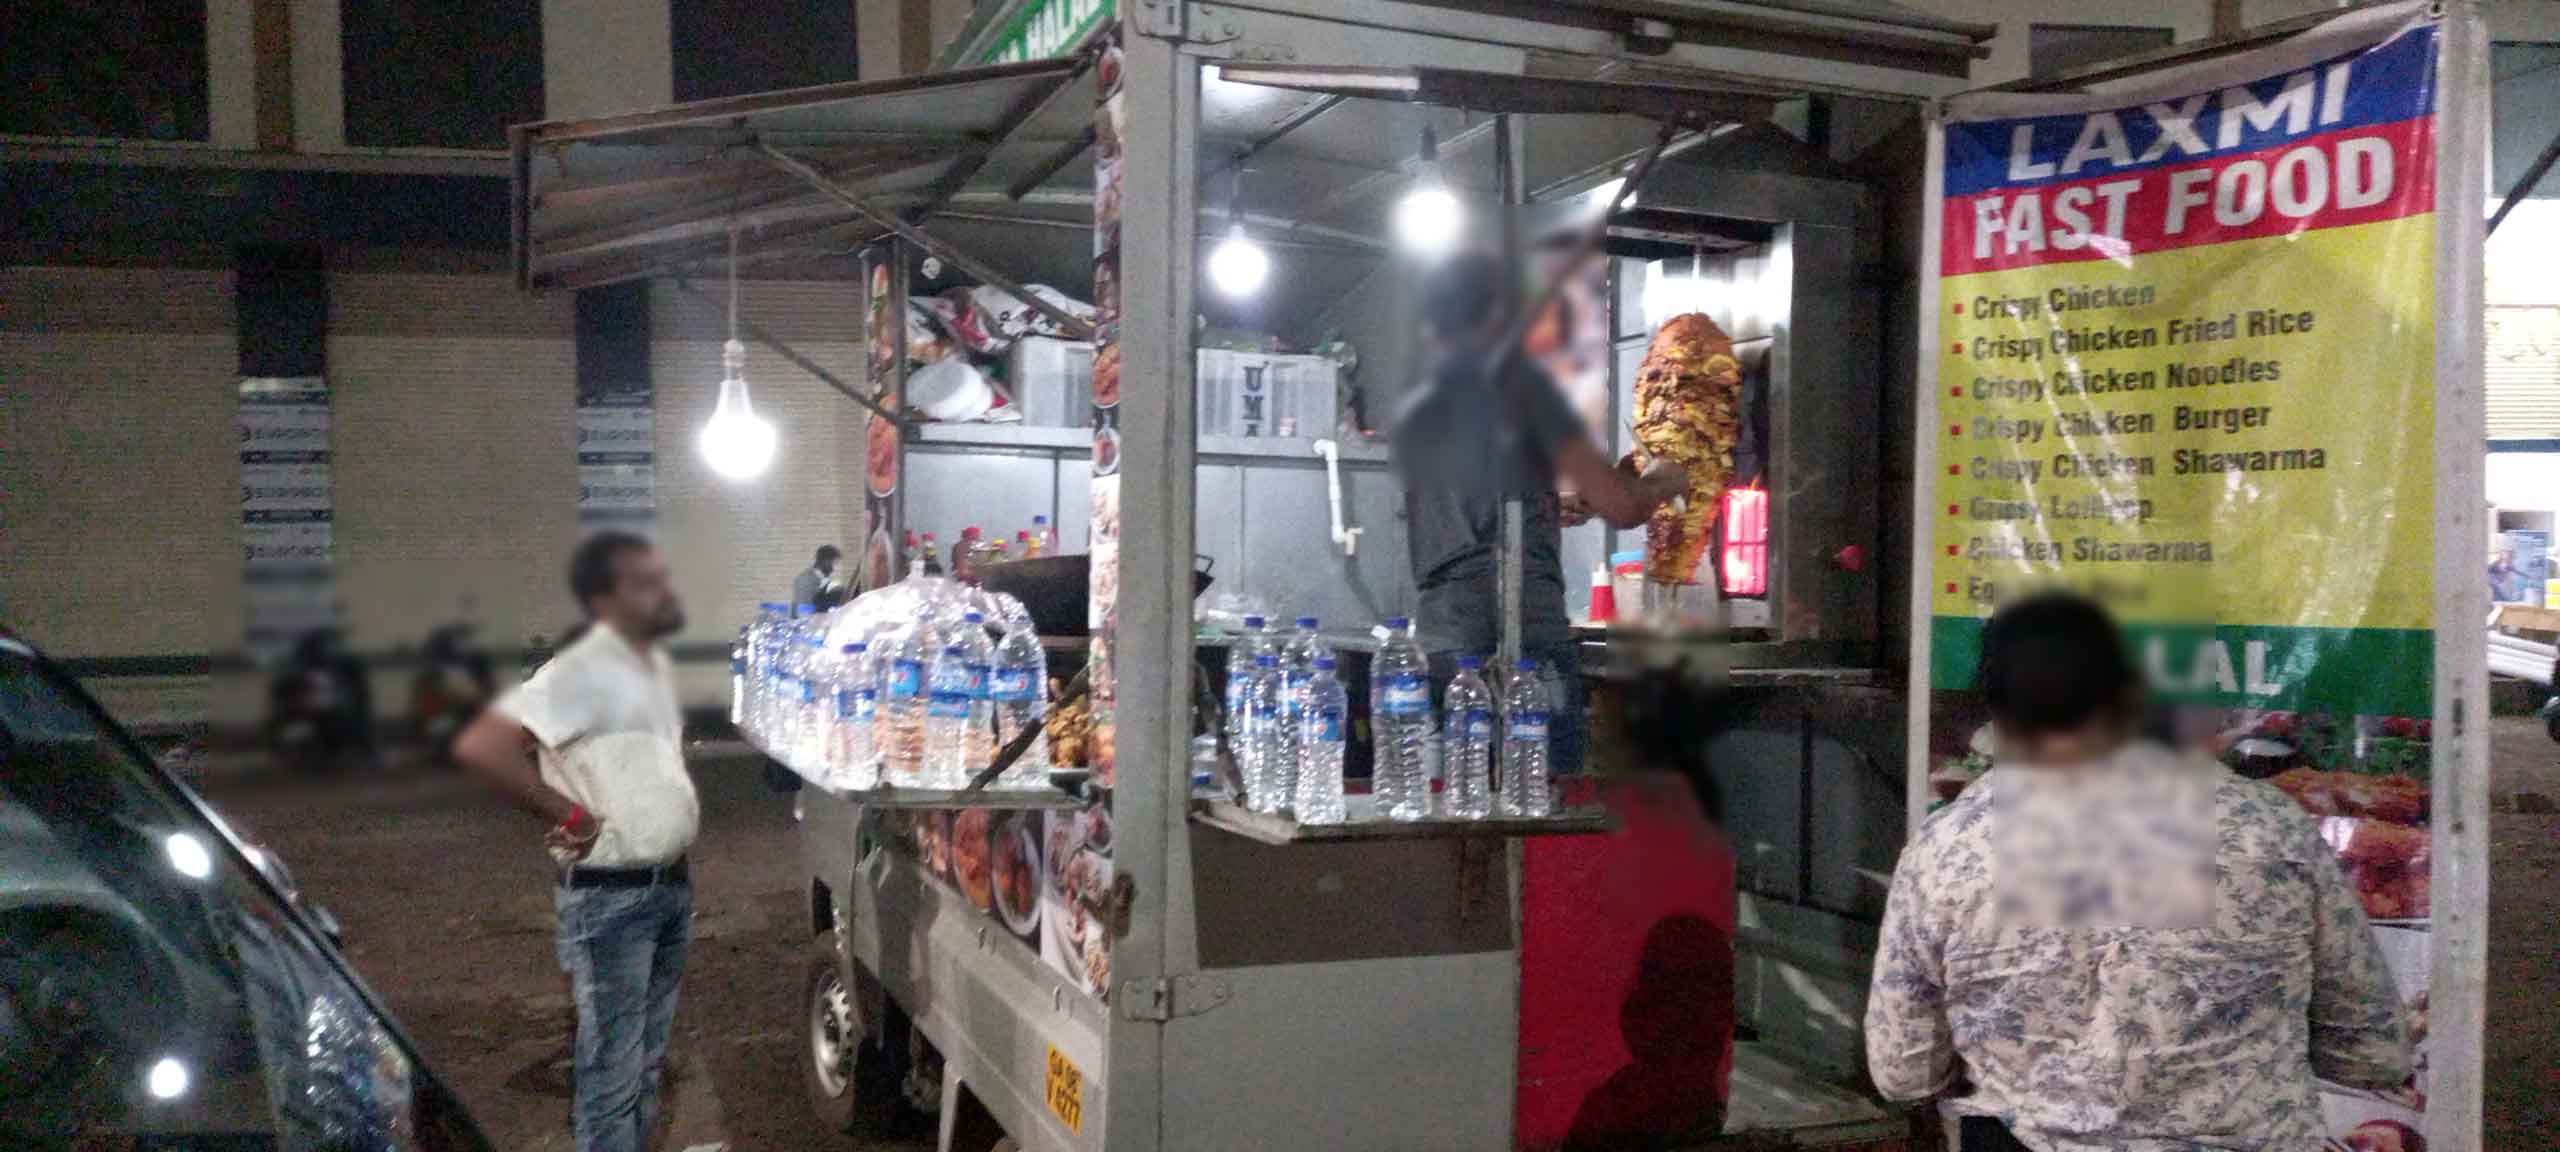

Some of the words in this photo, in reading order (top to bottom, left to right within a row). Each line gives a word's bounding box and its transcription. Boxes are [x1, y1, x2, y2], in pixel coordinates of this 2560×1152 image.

[2008, 62, 2351, 181] LAXMI
[1973, 180, 2142, 259] FAST
[2164, 136, 2395, 235] FOOD
[1974, 295, 2041, 322] Crispy
[2048, 285, 2155, 312] Chicken
[1973, 335, 2043, 363] Crispy
[2051, 325, 2156, 354] Chicken
[2167, 313, 2237, 346] Fried
[2247, 308, 2315, 338] Rice
[1973, 376, 2044, 402] Crispy
[2053, 368, 2155, 395] Chicken
[2166, 356, 2281, 388] Noodles
[1972, 416, 2045, 442] Crispy
[2055, 411, 2155, 437] Chicken
[2174, 404, 2272, 434] Burger
[2053, 453, 2155, 478] Chicken
[2174, 447, 2325, 476] Shawarma
[2073, 536, 2213, 562] Shawarma
